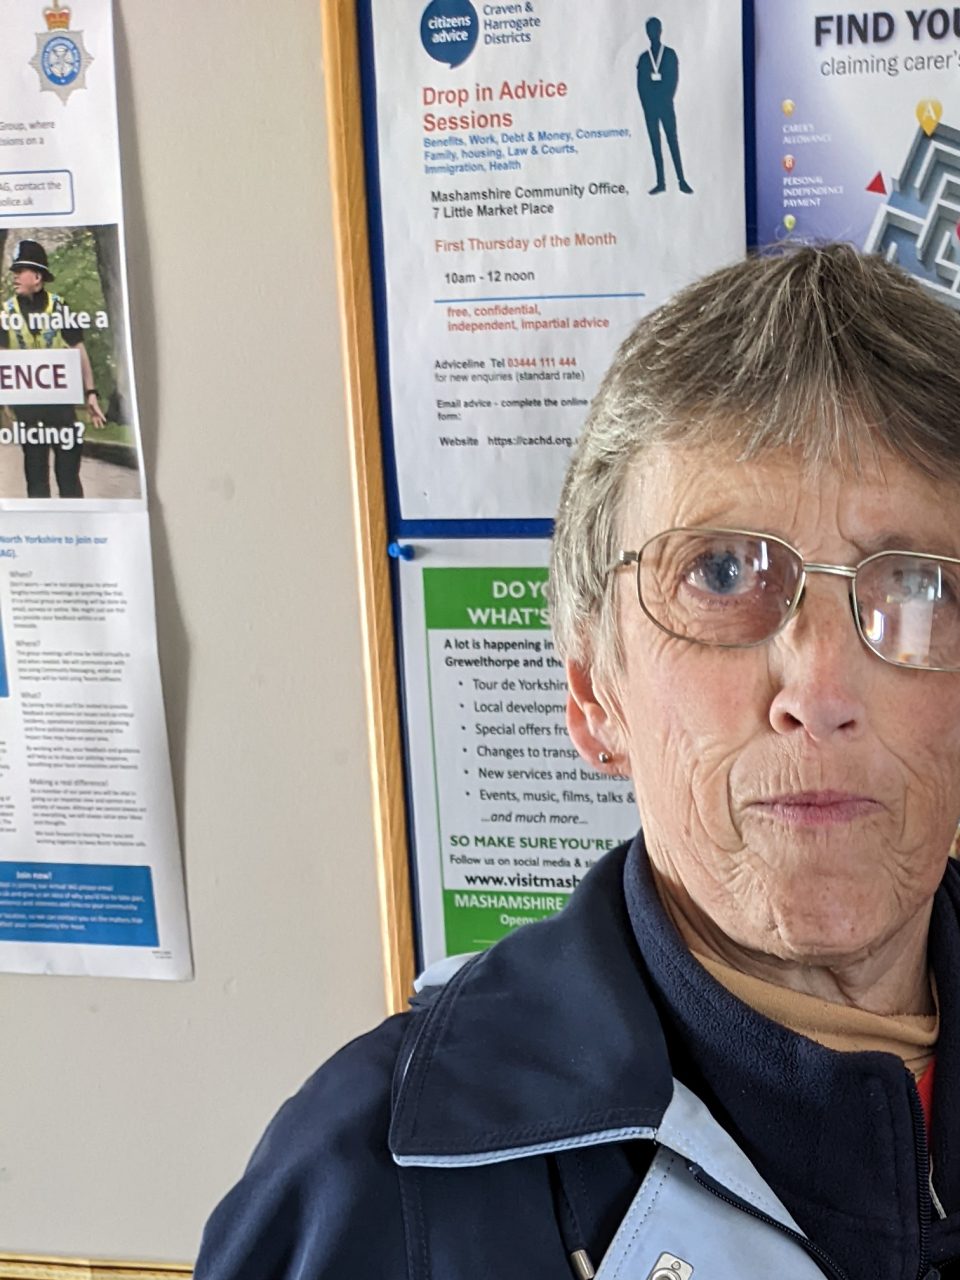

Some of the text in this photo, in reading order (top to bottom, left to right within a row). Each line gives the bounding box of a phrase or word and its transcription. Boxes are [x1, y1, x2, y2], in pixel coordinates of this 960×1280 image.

[483, 3, 534, 15] Craven &
[428, 16, 471, 29] citizens
[484, 17, 540, 30] Harrogate
[814, 12, 895, 46] FIND
[432, 29, 468, 42] advice
[484, 32, 530, 45] Districts
[821, 54, 899, 77] claiming
[423, 80, 568, 106] Drop in Advice
[922, 103, 935, 118] A
[424, 113, 513, 132] Sessions
[431, 183, 629, 203] Mashamshire Community Office,
[434, 204, 554, 218] 7 Little Market Place
[435, 232, 617, 252] First Thursday of the Month
[446, 270, 535, 284] 10am 12 noon
[1, 306, 108, 329] to make a
[448, 318, 609, 332] independent, impartial advice
[435, 358, 576, 370] Adviceline Tel 03444 111 444
[493, 582, 525, 598] DO
[445, 639, 554, 652] A lot is happening in
[446, 657, 543, 669] Grewelthorpe and
[480, 790, 623, 803] Events, music, films, talks
[450, 835, 470, 846] SO
[475, 836, 514, 848] MAKE
[520, 837, 556, 848] SURE
[455, 895, 563, 910] MASHAMSHIRE
